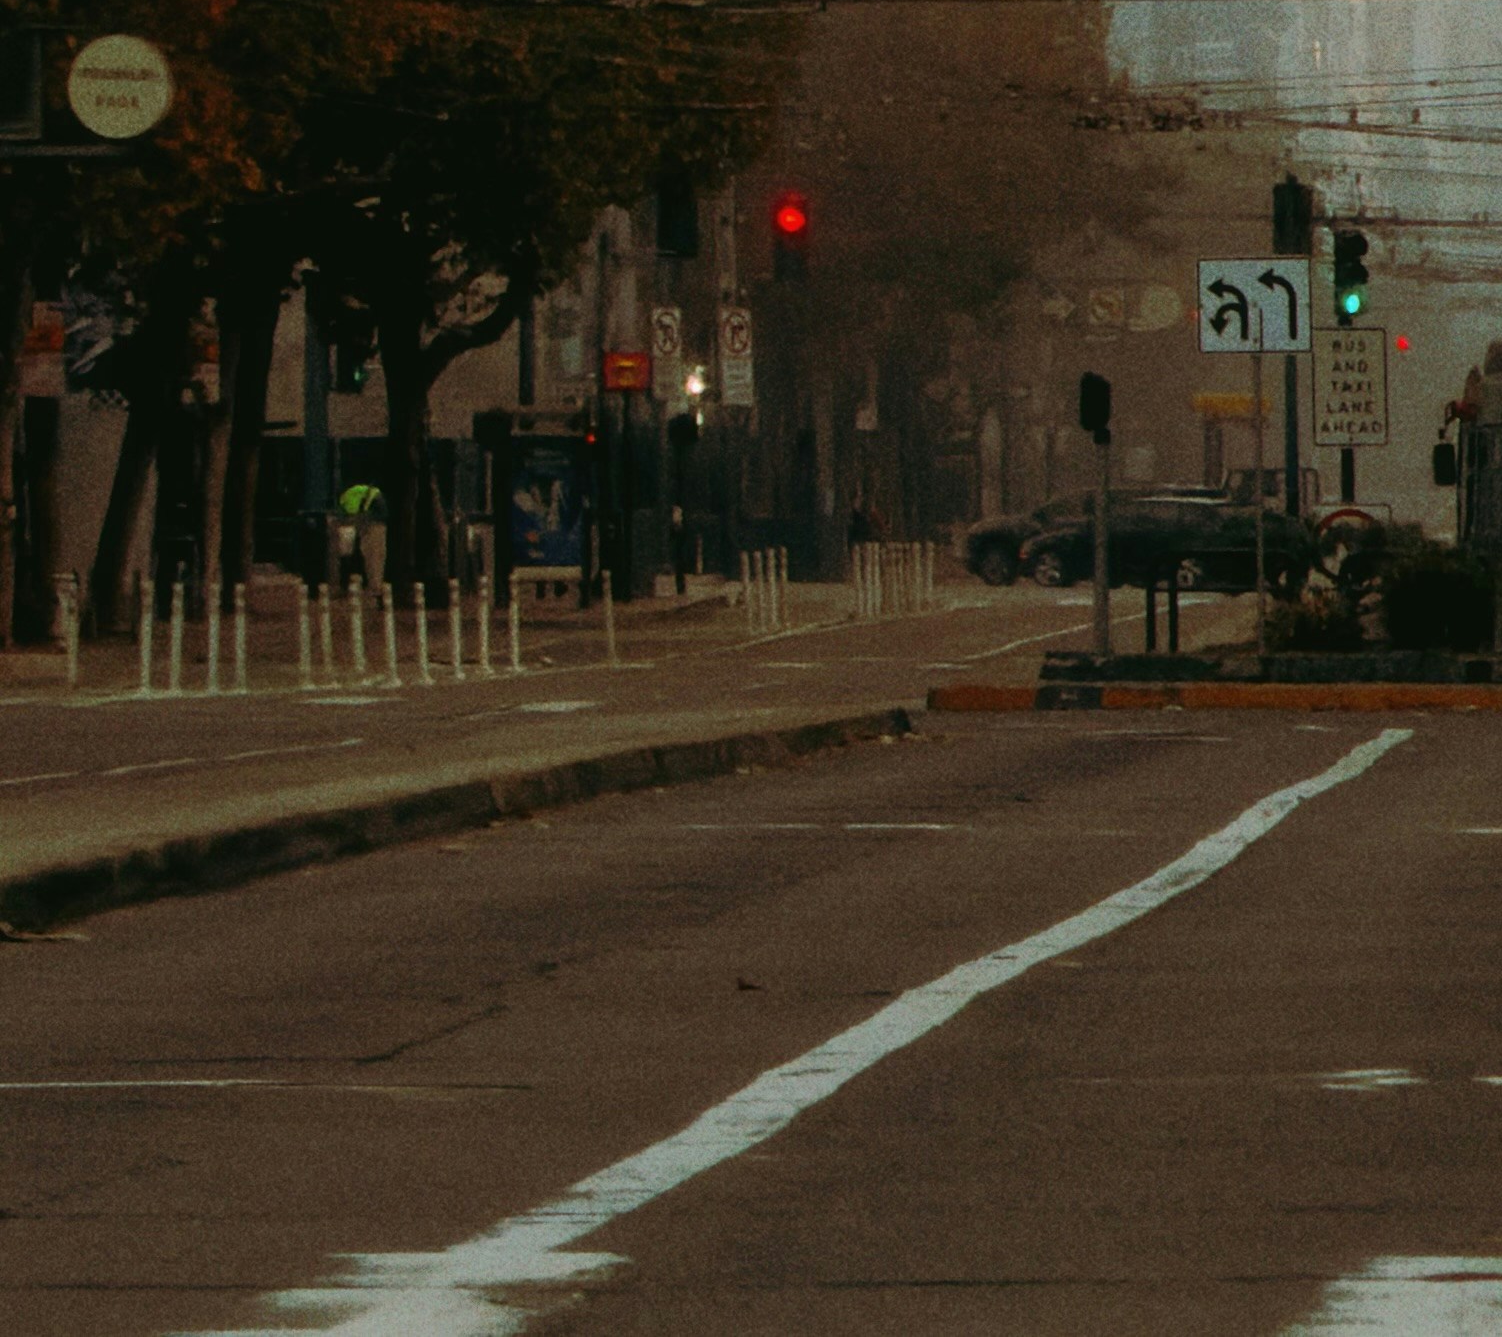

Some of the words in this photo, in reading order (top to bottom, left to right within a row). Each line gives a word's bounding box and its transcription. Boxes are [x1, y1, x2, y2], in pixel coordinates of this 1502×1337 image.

[1332, 339, 1367, 352] BUS
[1332, 360, 1368, 373] AND
[1330, 380, 1372, 393] TAXI
[1326, 400, 1375, 414] LANE
[1321, 421, 1383, 434] AHEAD
